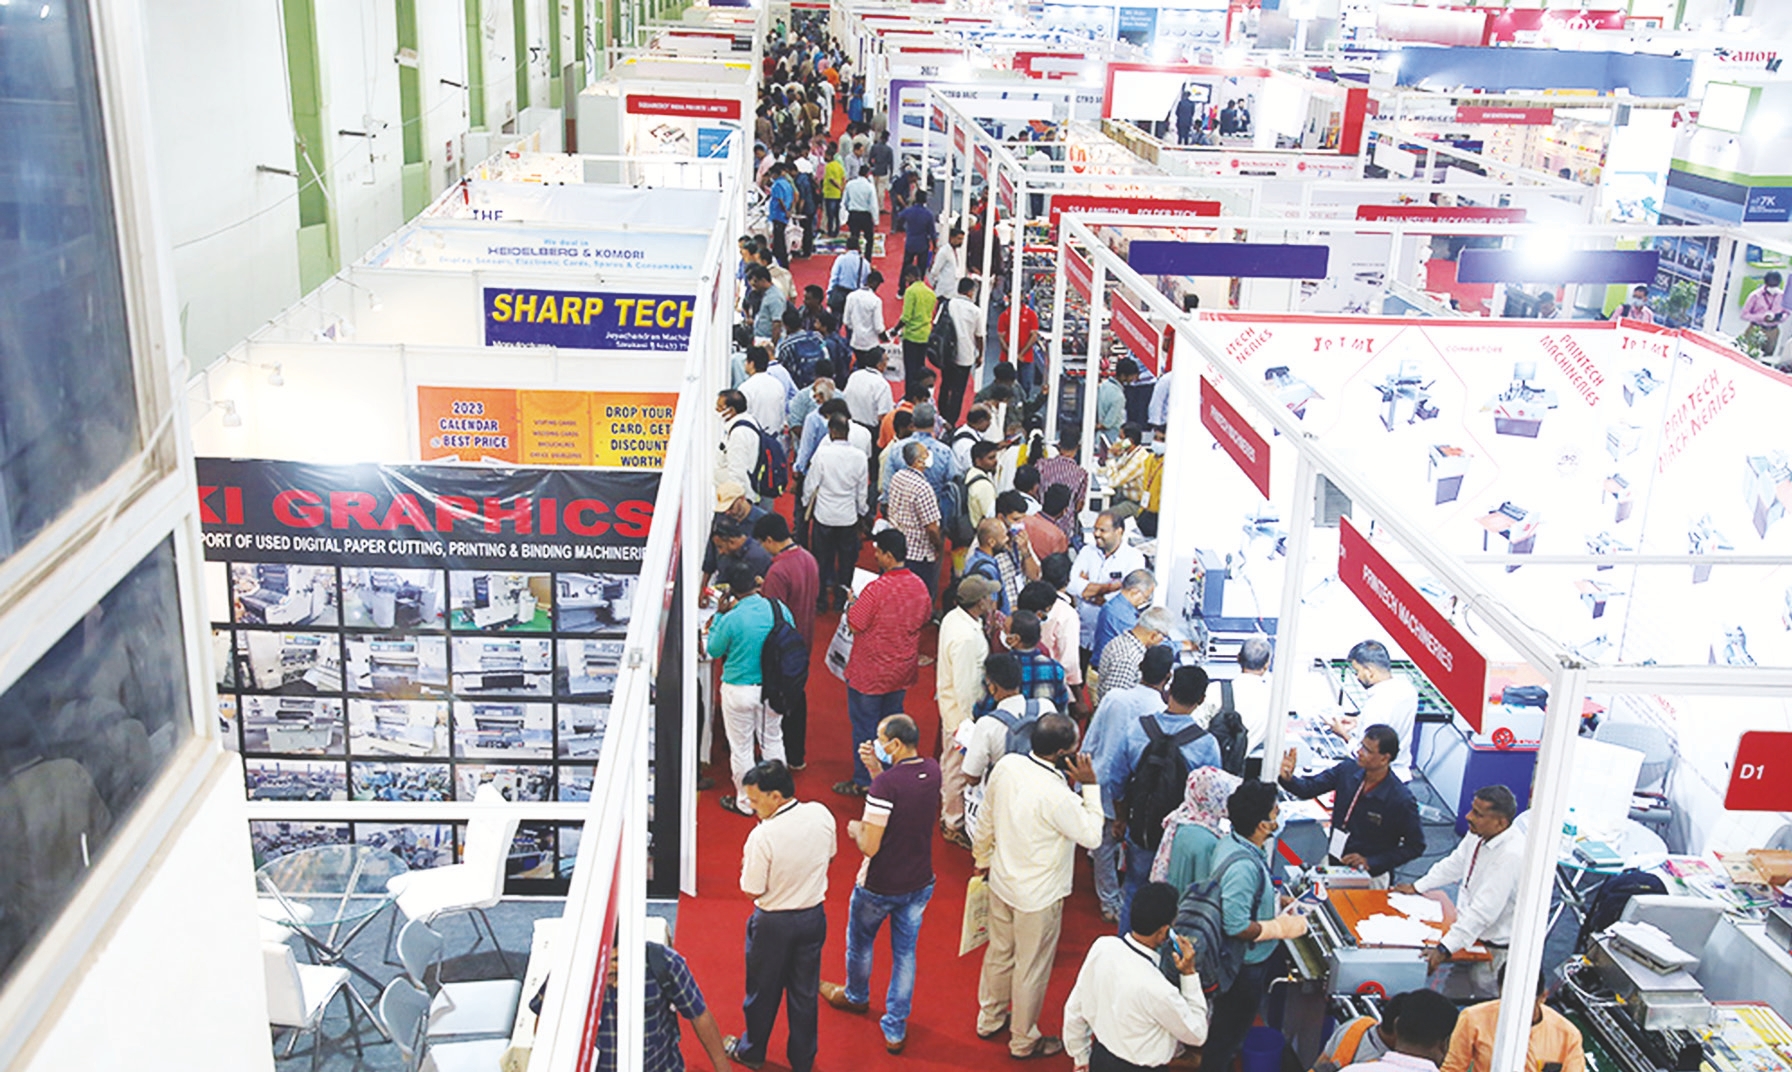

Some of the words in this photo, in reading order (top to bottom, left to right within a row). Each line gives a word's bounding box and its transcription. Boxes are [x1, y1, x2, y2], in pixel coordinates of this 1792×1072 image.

[488, 246, 578, 257] HEIDELBERG
[595, 249, 644, 260] KOMORI
[492, 293, 604, 325] SHARP
[614, 298, 695, 329] TECH
[1559, 334, 1605, 387] PRINTECH
[452, 402, 484, 415] 2023
[606, 406, 636, 418] DROP
[641, 407, 673, 419] YOUR
[439, 420, 499, 431] CALENDAR
[611, 423, 646, 436] CARD,
[650, 424, 671, 435] GET
[443, 436, 470, 447] BEST
[474, 437, 508, 448] PRICE
[611, 439, 669, 451] DISCOUNT
[620, 455, 662, 467] WORTH
[272, 489, 655, 538] GRAPHICS
[235, 533, 253, 548] OF
[256, 535, 291, 550] USED
[293, 537, 342, 553] DIGITAL
[344, 538, 387, 554] PAPER
[388, 540, 446, 558] CUTTING,
[449, 541, 507, 558] PRINTING
[510, 543, 519, 558] &
[522, 544, 572, 559] BINDING
[1363, 564, 1398, 615] PRINTECH
[1398, 602, 1454, 672] MACHINERIES
[1739, 763, 1765, 780] D1
